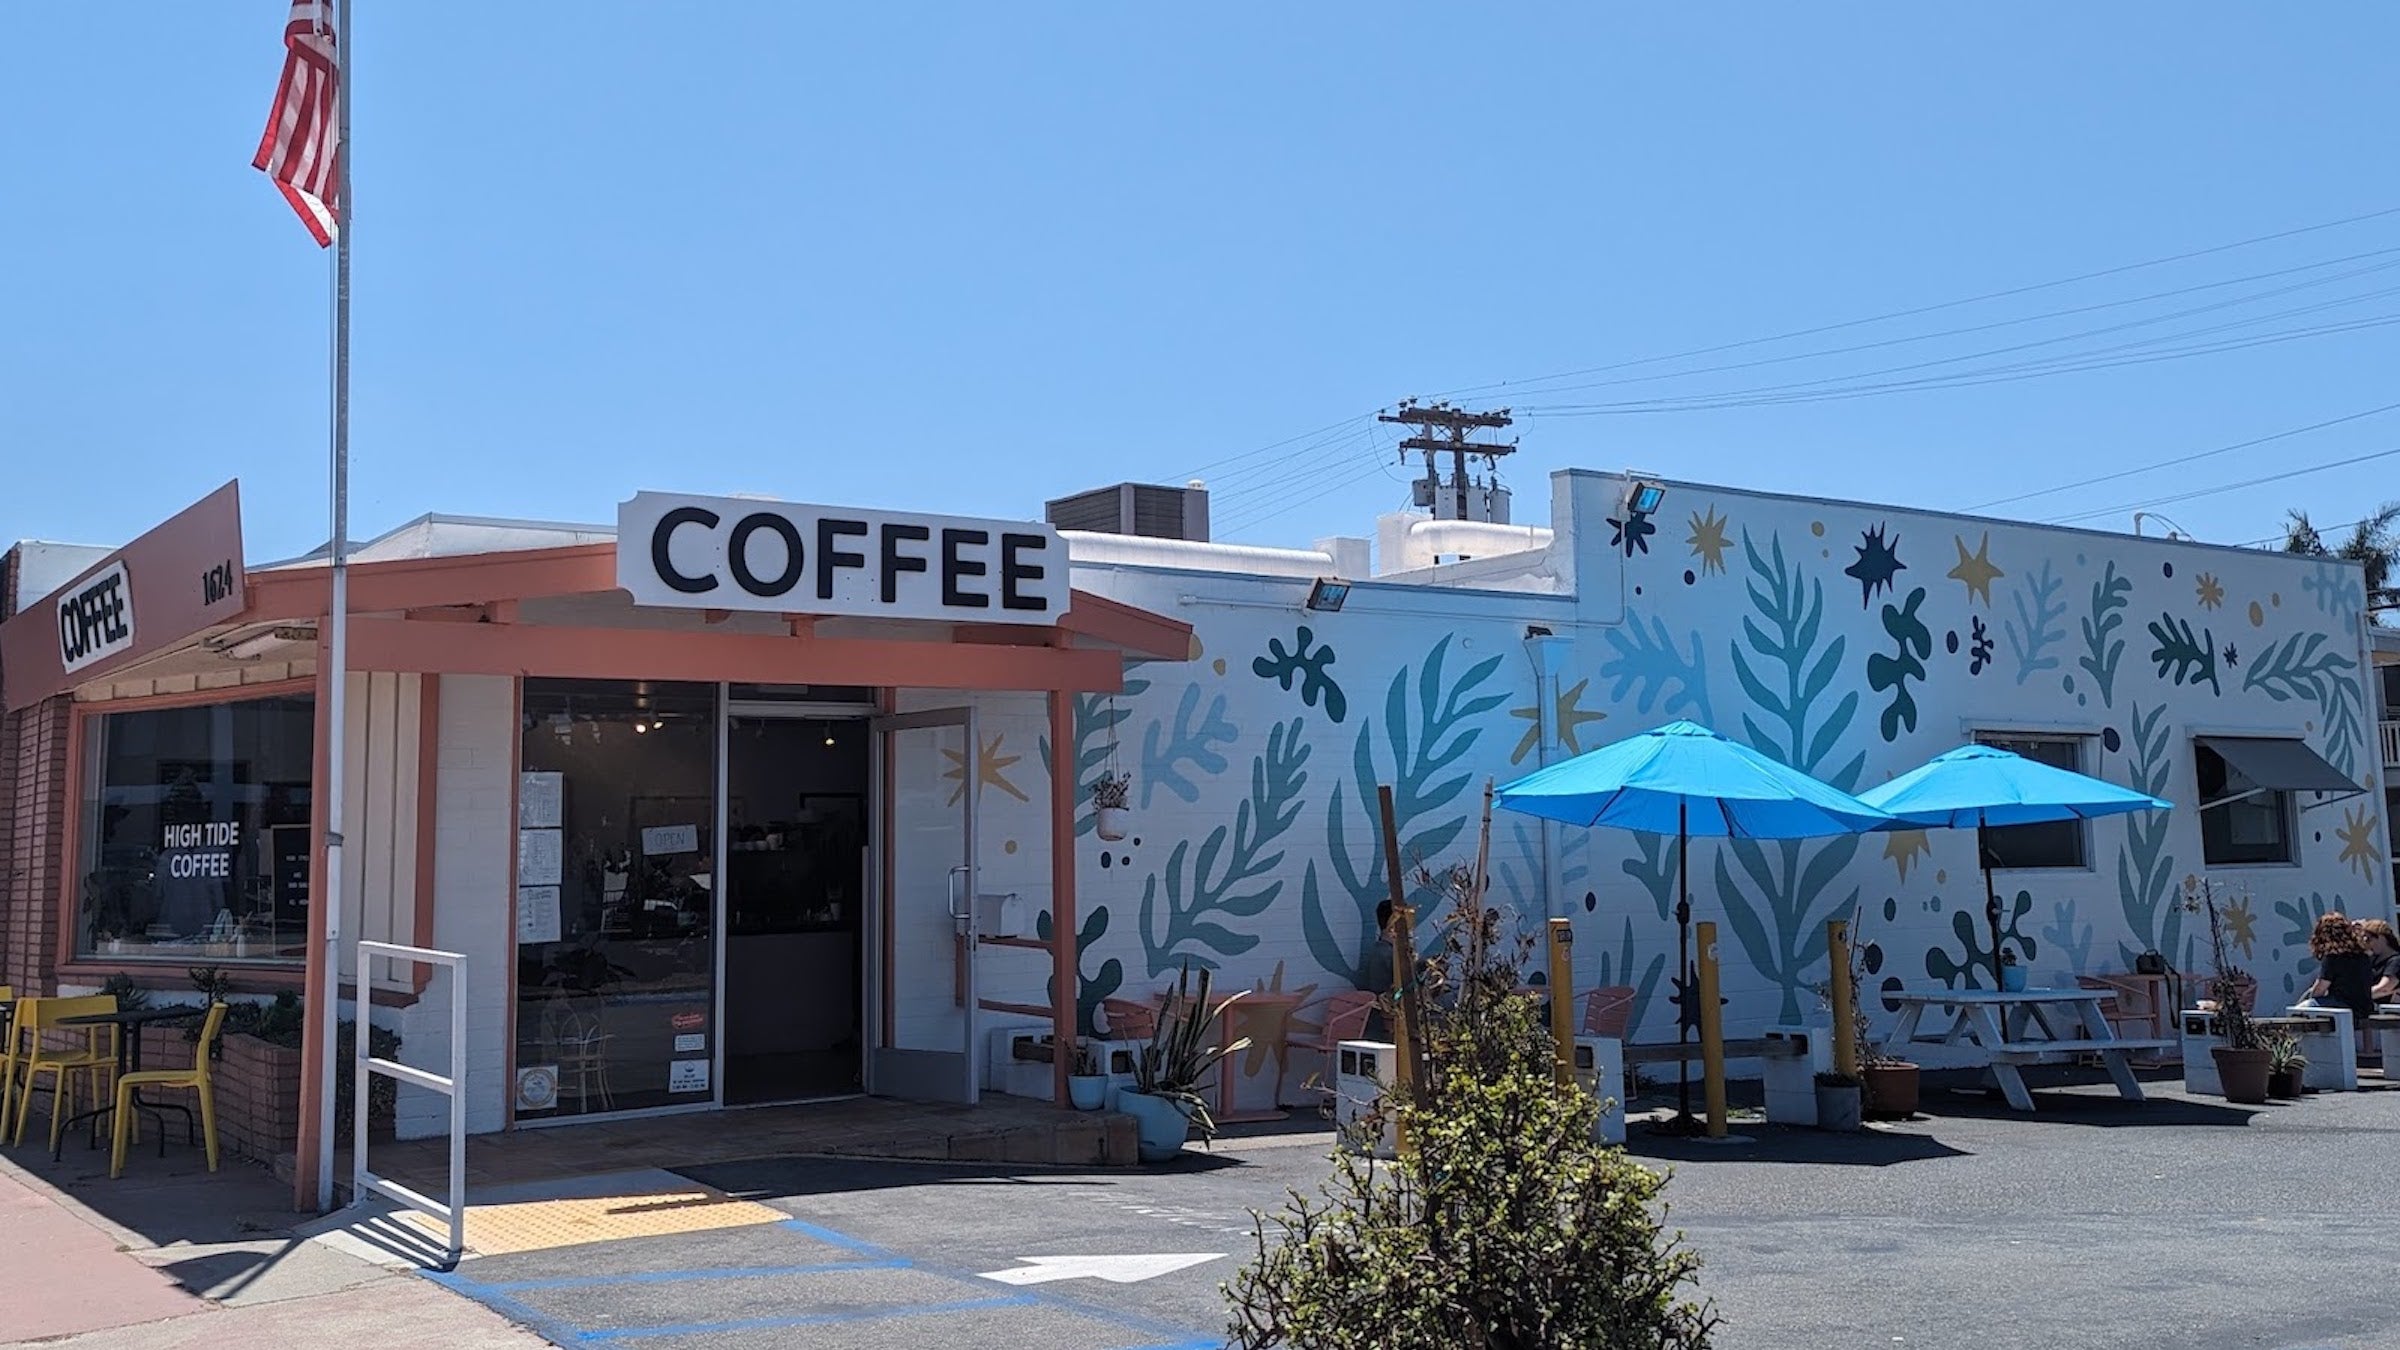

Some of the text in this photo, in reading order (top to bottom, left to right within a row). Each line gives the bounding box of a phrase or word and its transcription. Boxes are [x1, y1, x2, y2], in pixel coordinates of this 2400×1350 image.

[652, 506, 1047, 610] COFFEE
[202, 559, 232, 606] 1624
[61, 572, 128, 663] COFFEE
[164, 821, 240, 848] HIGH TIDE
[655, 832, 685, 847] OPEN
[170, 853, 230, 878] COFFEE
